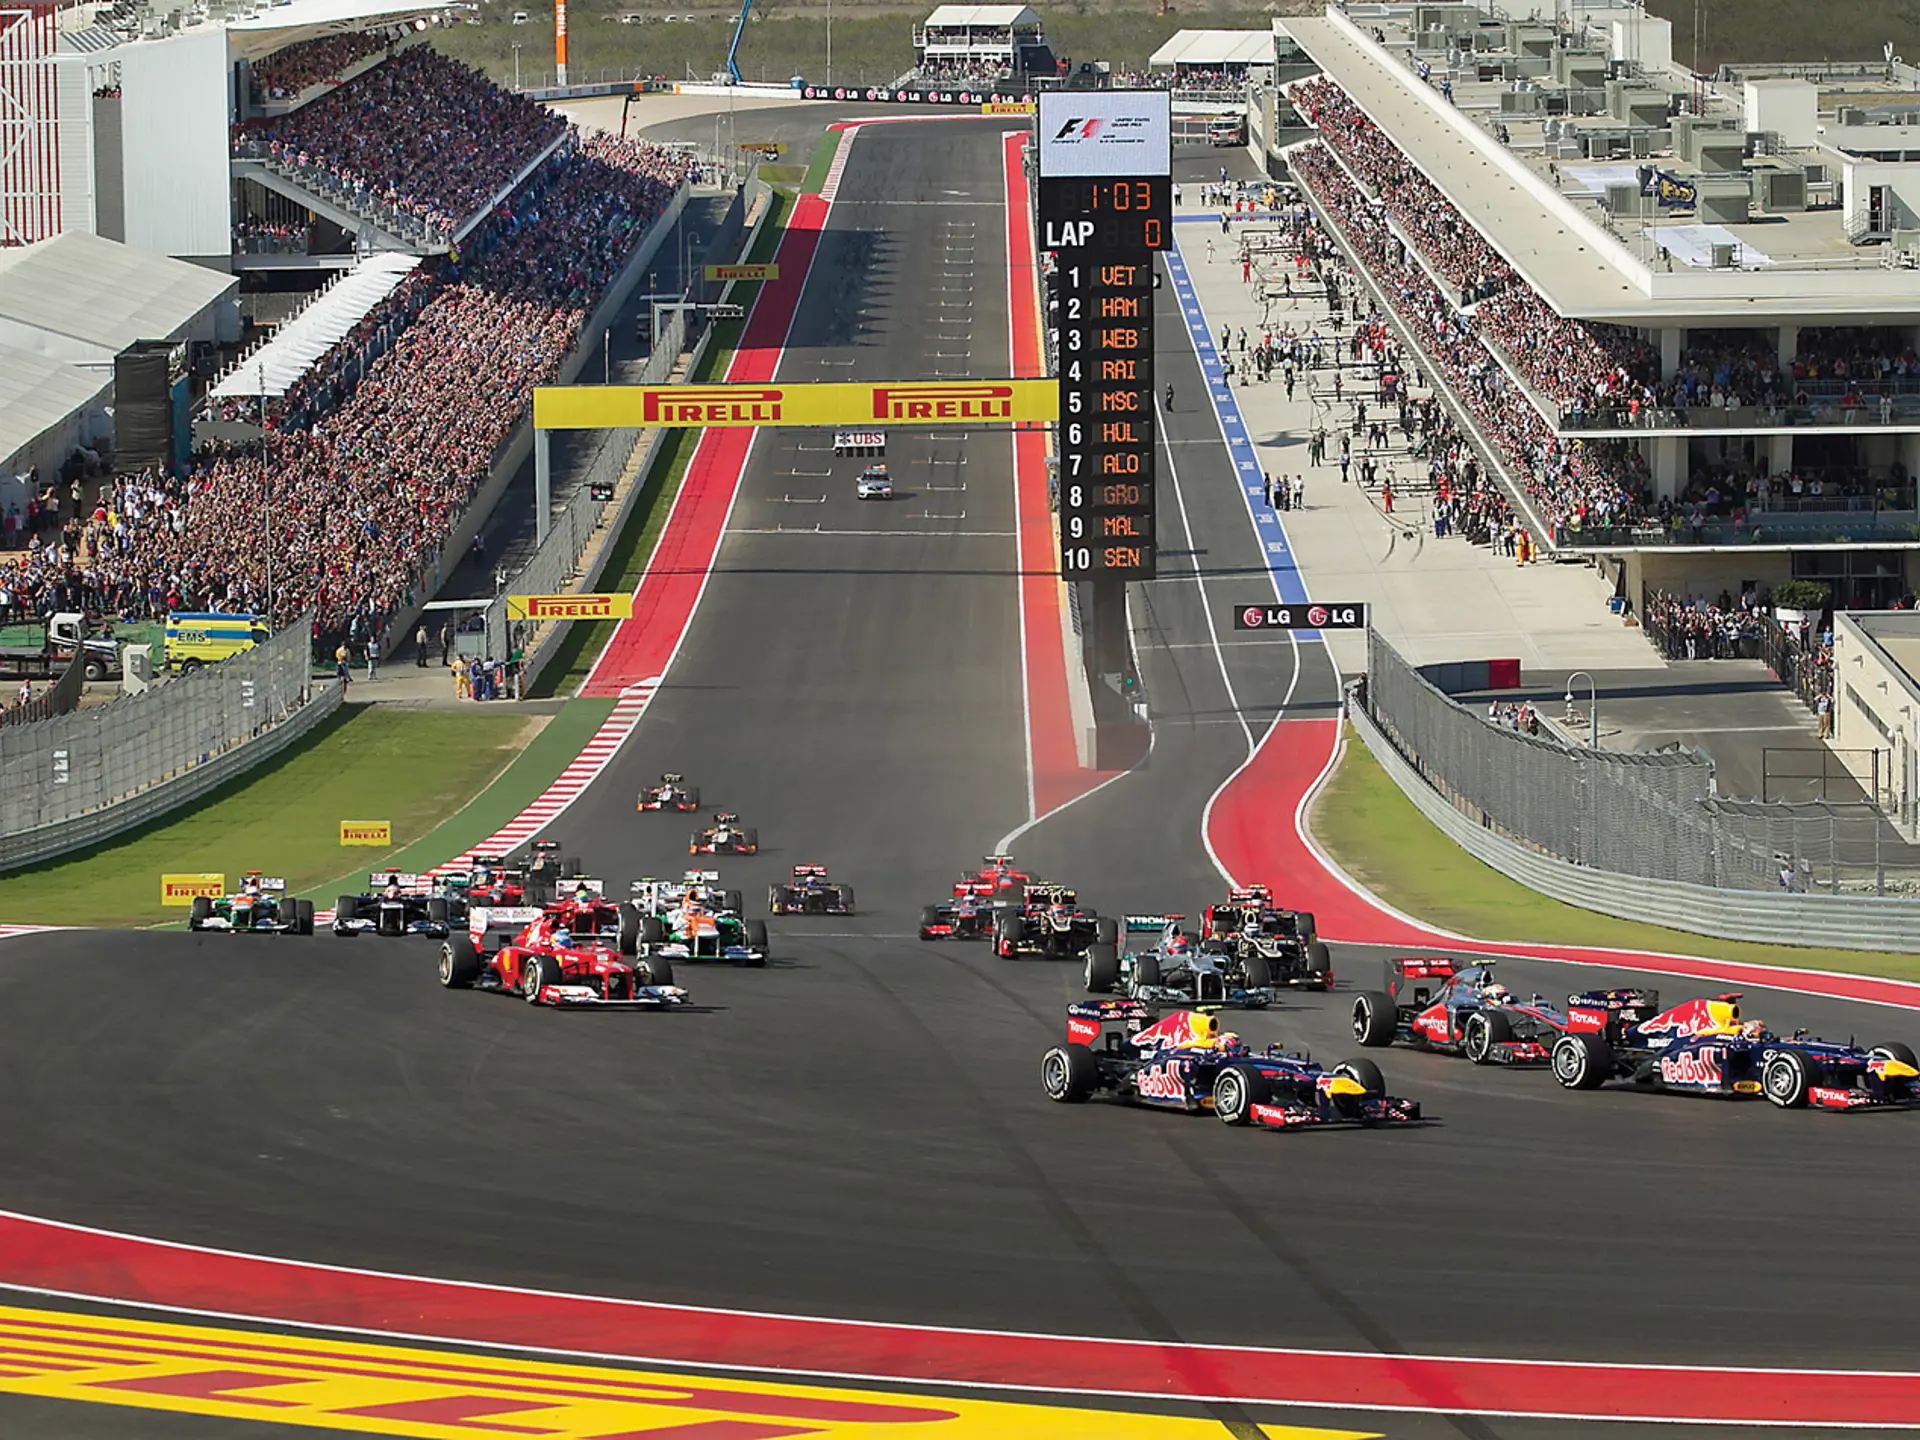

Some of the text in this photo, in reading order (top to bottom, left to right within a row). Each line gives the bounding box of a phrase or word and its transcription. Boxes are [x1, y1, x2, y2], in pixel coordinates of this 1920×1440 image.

[816, 88, 828, 98] LG
[847, 89, 858, 99] LG
[909, 91, 920, 101] LG
[940, 92, 952, 102] LG
[971, 93, 982, 103] LG
[1092, 182, 1151, 210] 1:03
[1046, 219, 1161, 247] LAP 0
[716, 267, 767, 279] PIRELLI
[1068, 266, 1136, 288] 1 VET
[1067, 298, 1138, 319] 2 HAM
[1068, 328, 1139, 350] 3 WEB
[1068, 360, 1136, 382] 4 RAI
[643, 386, 1013, 422] PIRELLI PIRELLI
[1069, 391, 1139, 413] 5 MSC
[853, 433, 883, 445] UBS
[1068, 423, 1138, 445] 6 HUL
[1069, 454, 1139, 476] 7 ALO
[1069, 485, 1140, 507] 8 GRO
[1070, 516, 1140, 539] 9 MAL
[1064, 547, 1141, 570] 10 SEN
[528, 597, 612, 617] PIRELLI
[1267, 609, 1355, 624] LG LG
[178, 632, 206, 643] EMS
[343, 828, 388, 840] PIRELLI
[166, 883, 222, 897] PIRELLI
[1068, 1020, 1095, 1036] TOTAL
[1568, 1011, 1601, 1026] TOTAL
[1814, 1087, 1848, 1101] TOTAL
[1256, 1104, 1284, 1120] TOTAL
